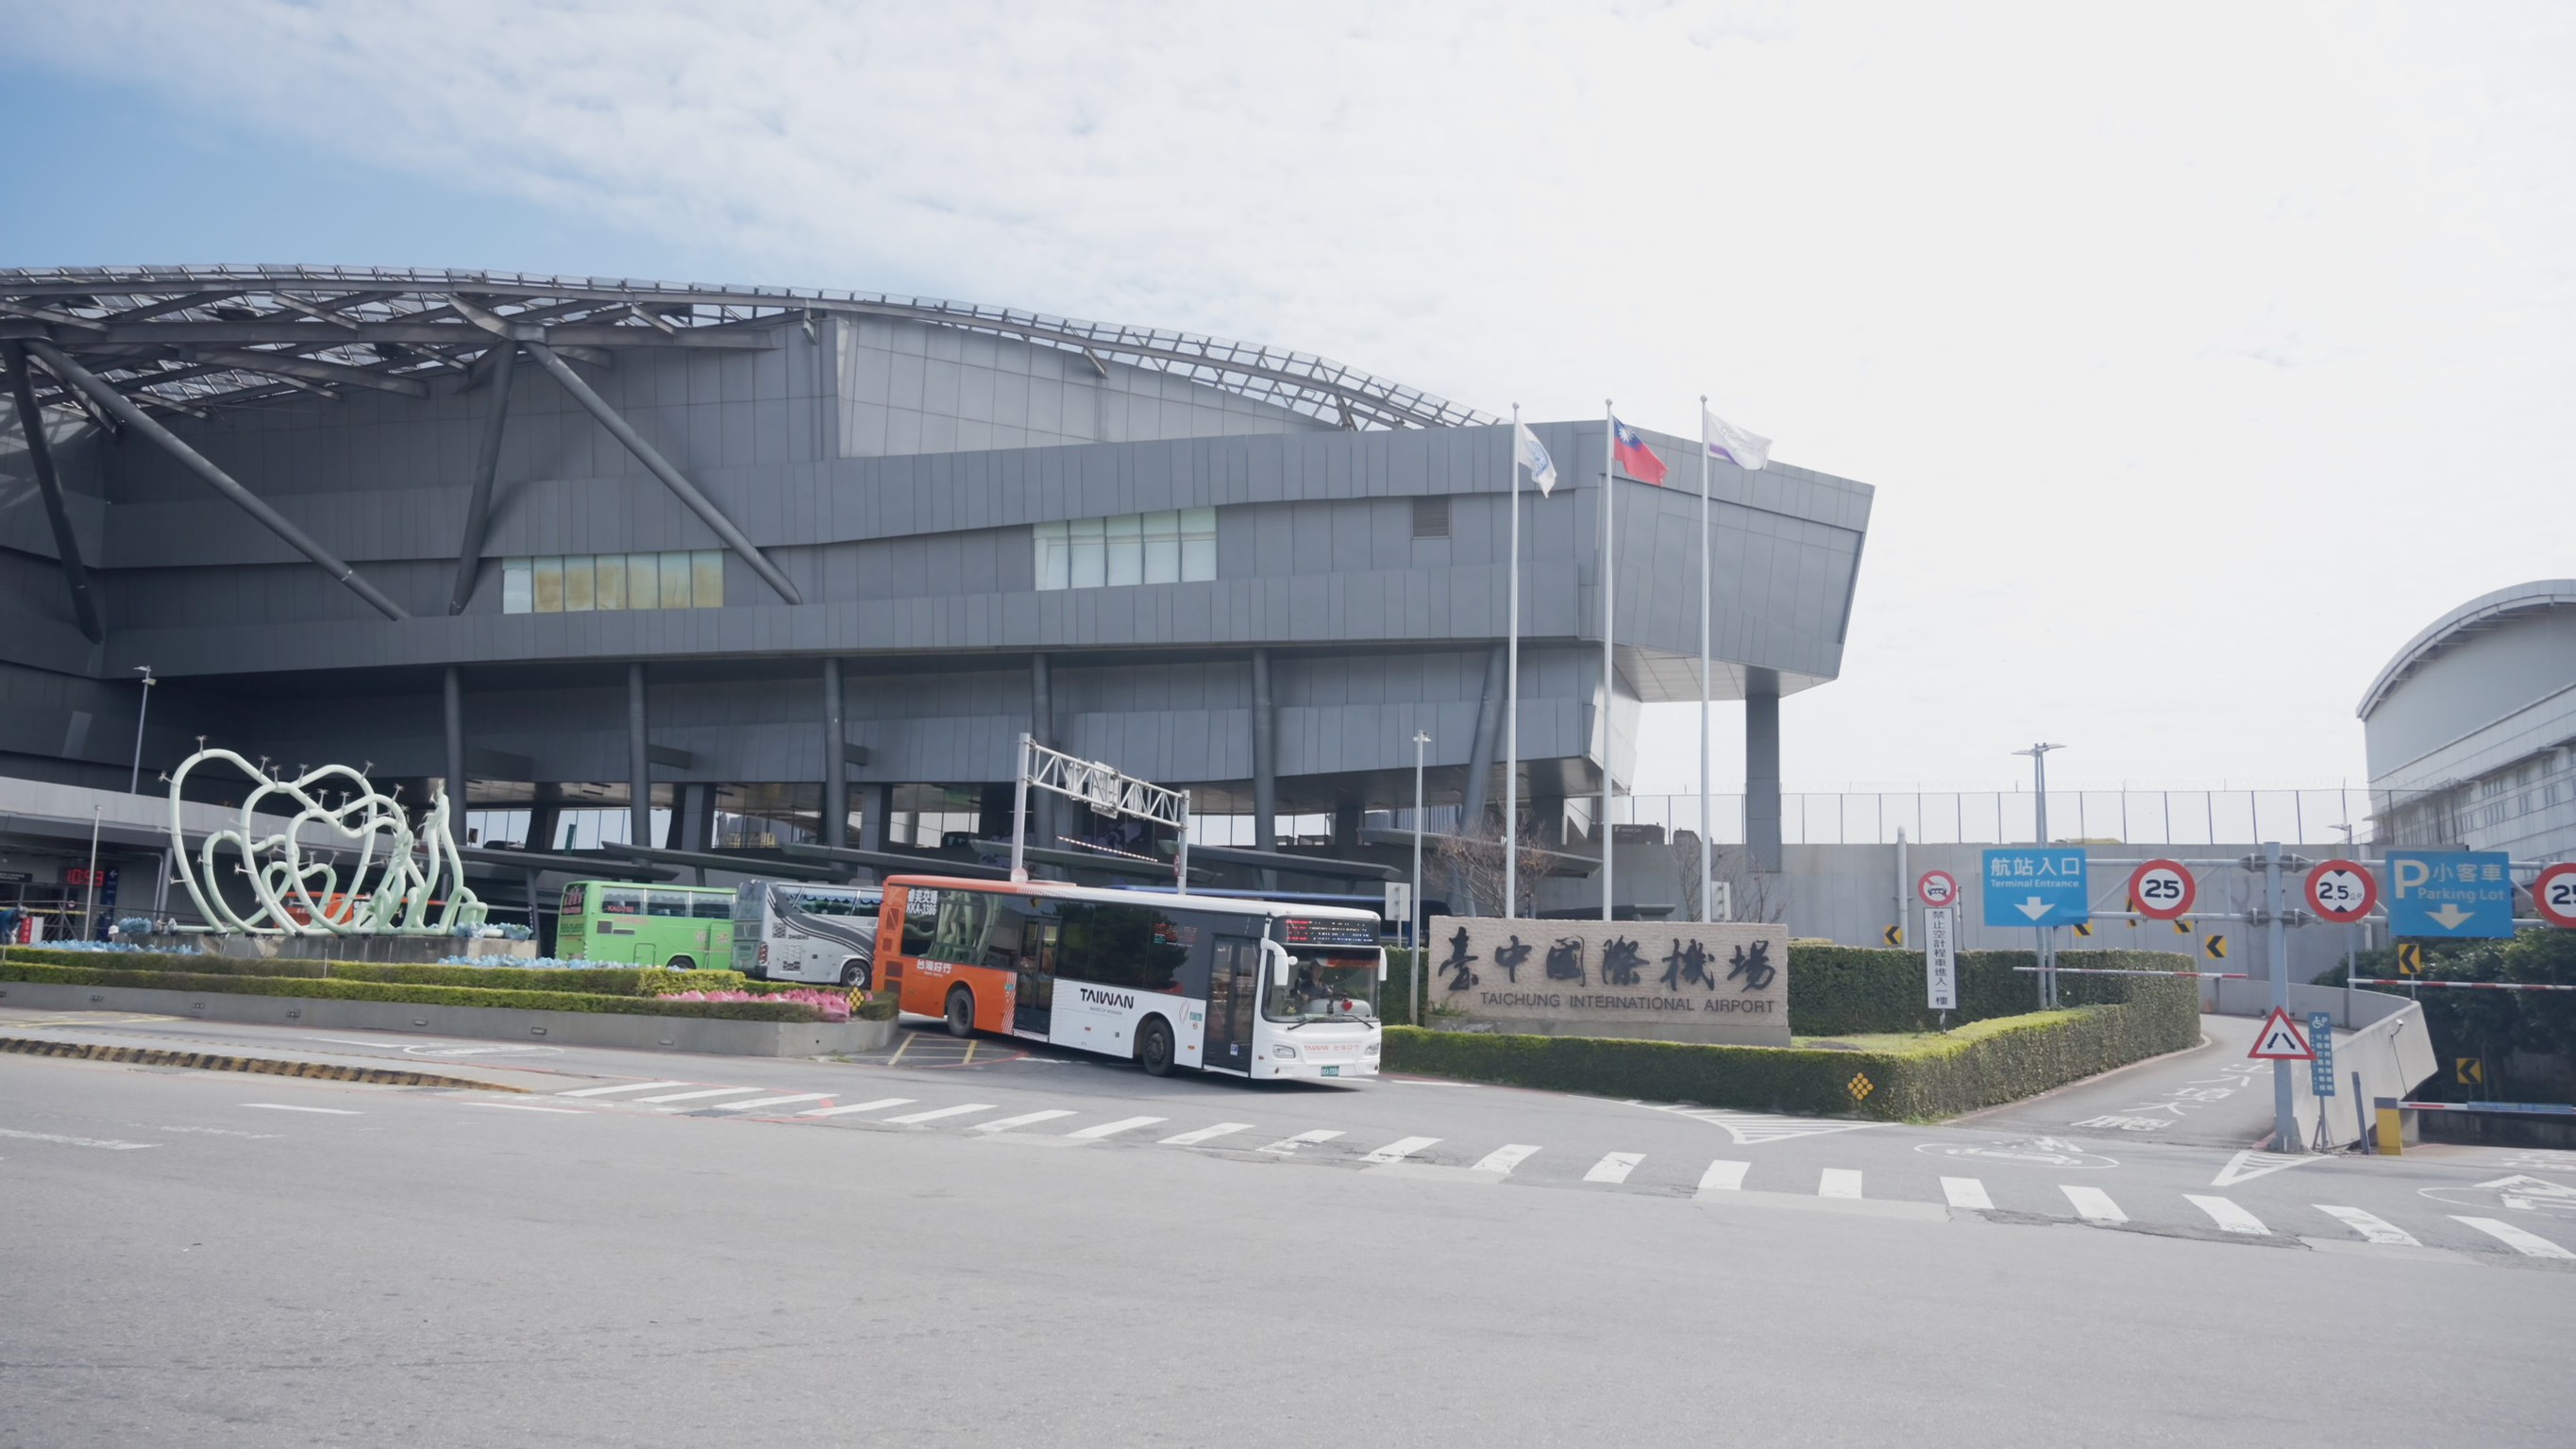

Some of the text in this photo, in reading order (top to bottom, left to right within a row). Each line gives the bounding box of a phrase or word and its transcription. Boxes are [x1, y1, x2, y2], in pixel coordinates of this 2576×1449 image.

[1991, 857, 2079, 876] 航站入口
[2433, 863, 2503, 883] 小客車
[1991, 879, 2079, 888] Terminal Entrance
[2144, 879, 2180, 899] 25
[2393, 860, 2430, 899] P
[2319, 882, 2349, 901] 2.5
[2417, 888, 2504, 903] Parking Lot
[2551, 884, 2576, 905] 2
[906, 902, 937, 916] KKA-3386
[917, 959, 951, 973] 台灣好行
[1439, 925, 1776, 992] 臺中國際機場
[1932, 910, 1948, 1004] 禁止空計程車進入一樓
[1080, 987, 1135, 1009] TAIWAN
[1480, 991, 1775, 1013] TAICHUNG INTERNATIONAL AIRPORT
